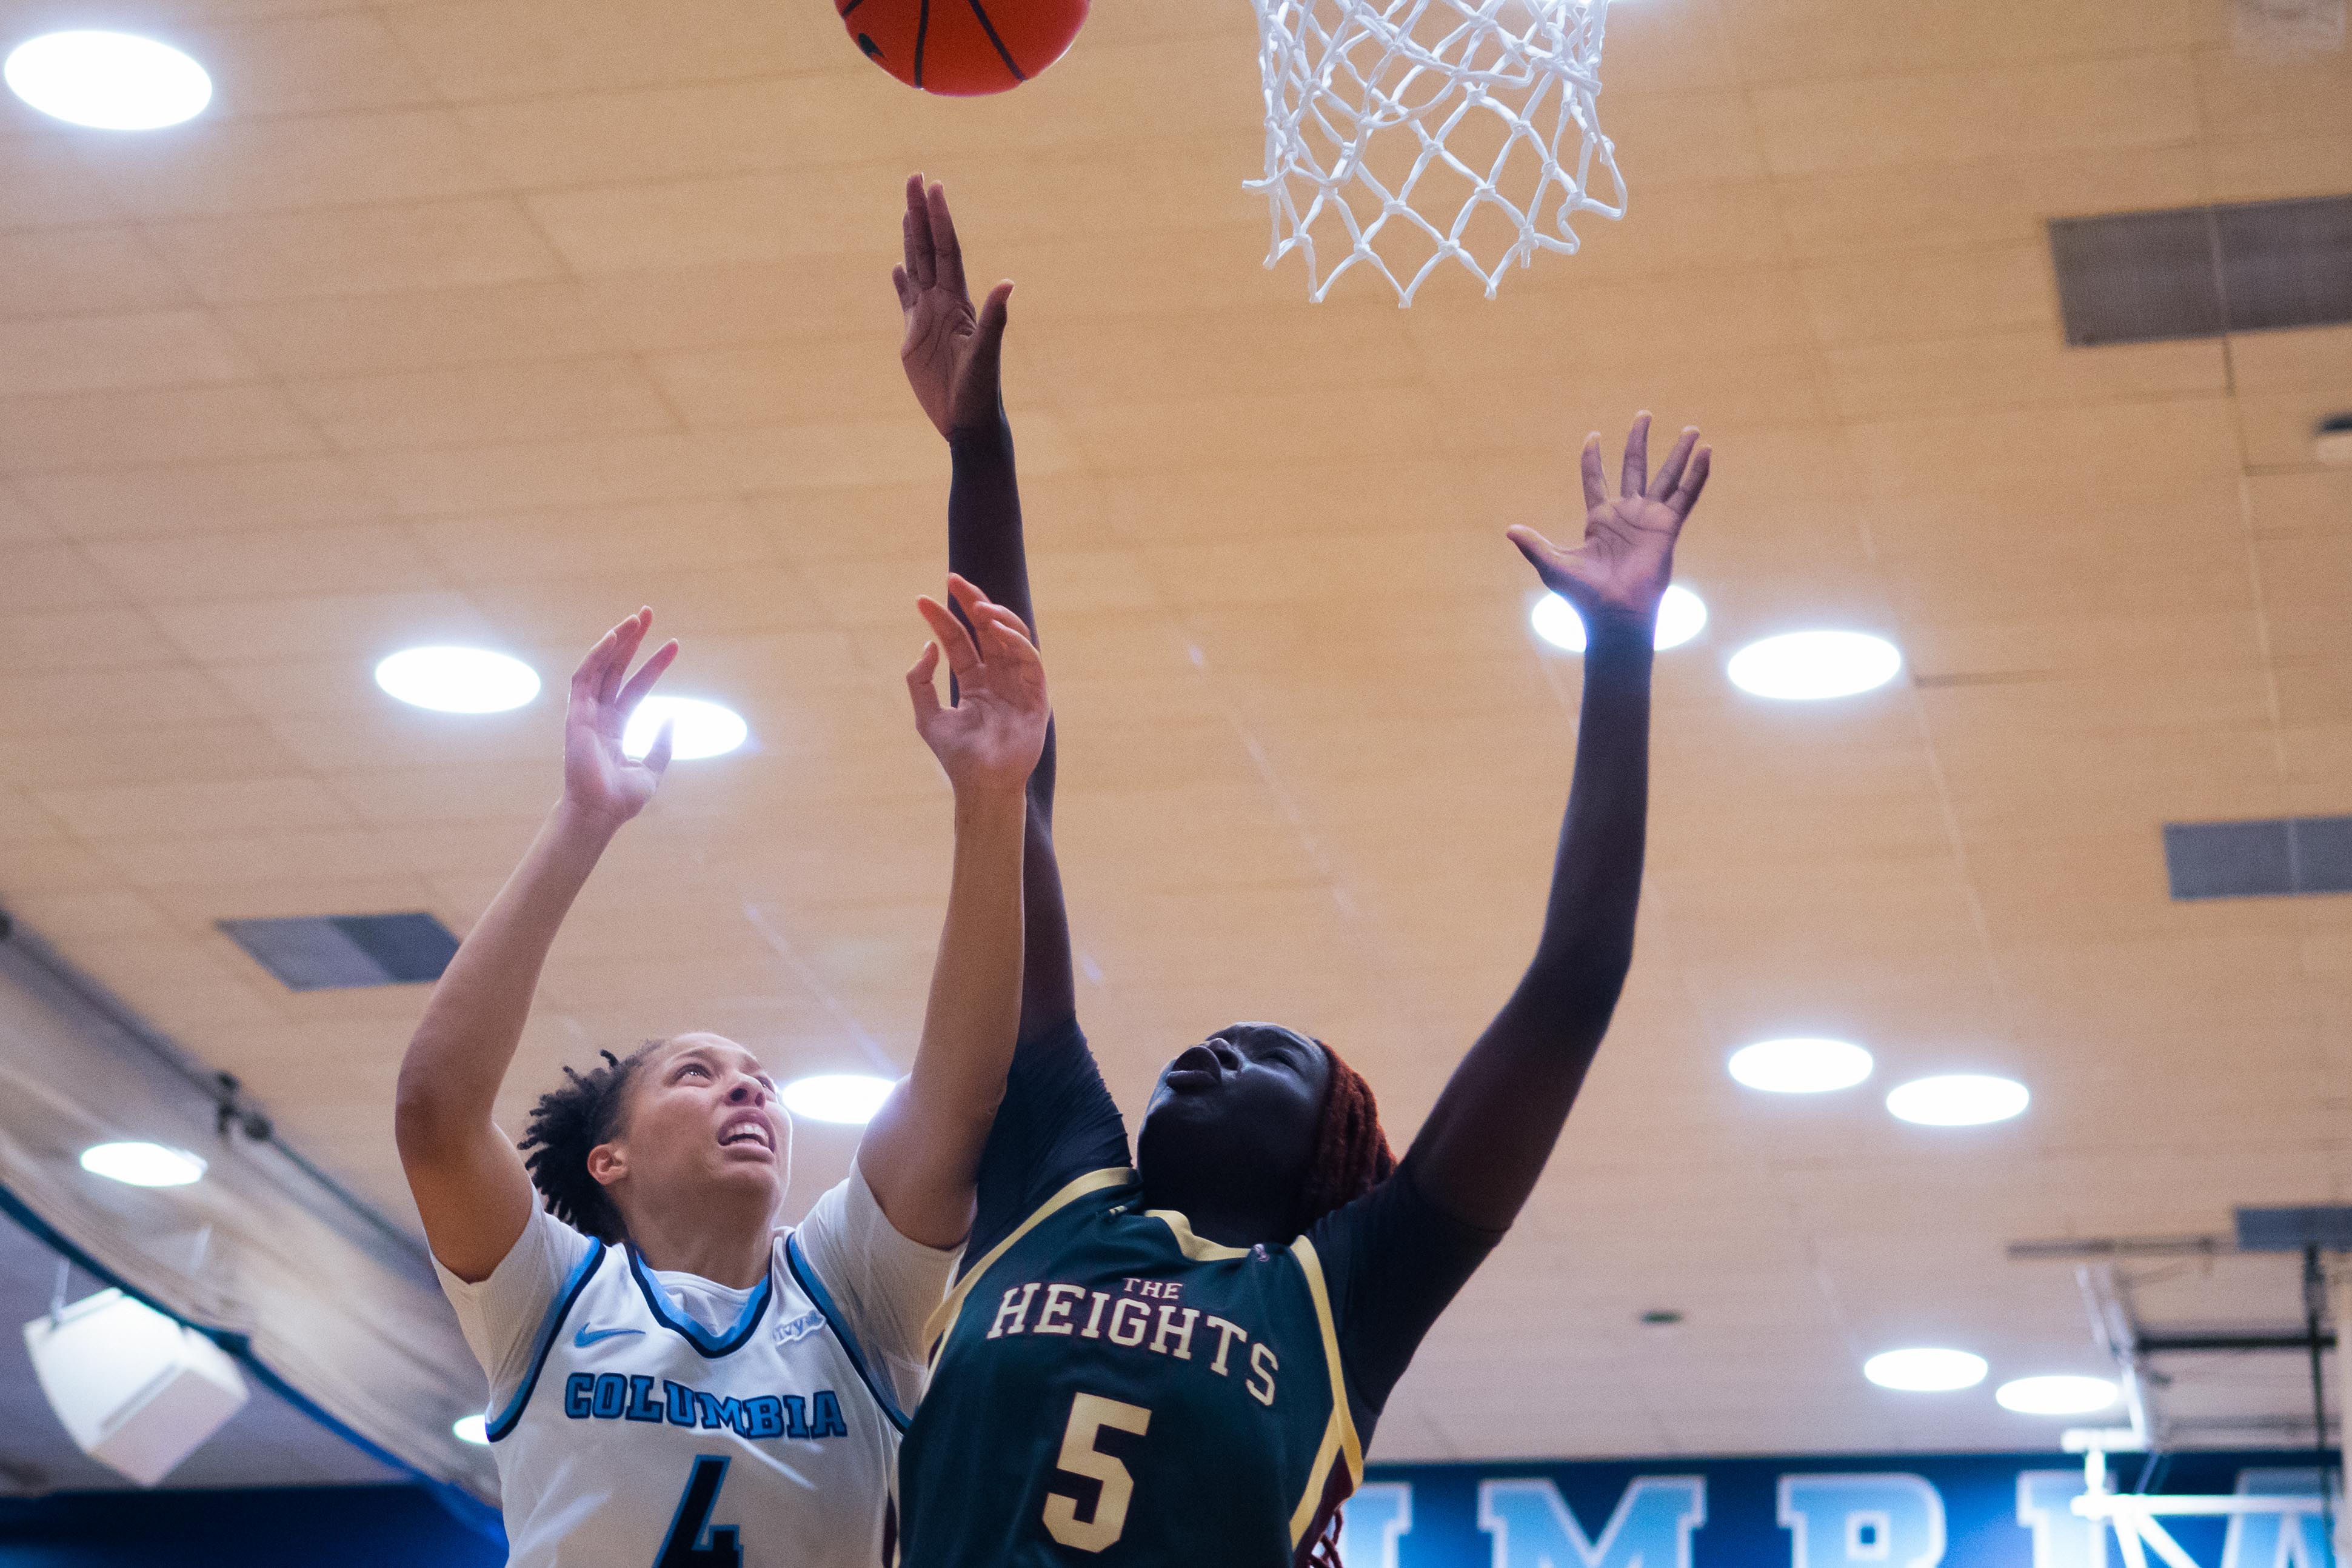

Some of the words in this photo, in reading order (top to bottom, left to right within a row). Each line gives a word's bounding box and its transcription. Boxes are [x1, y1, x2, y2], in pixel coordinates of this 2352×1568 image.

[986, 1282, 1279, 1407] HEIGHTS
[1123, 1277, 1183, 1300] THE
[564, 1372, 849, 1439] COLUMBIA
[651, 1454, 744, 1568] 4
[1042, 1391, 1152, 1553] 5
